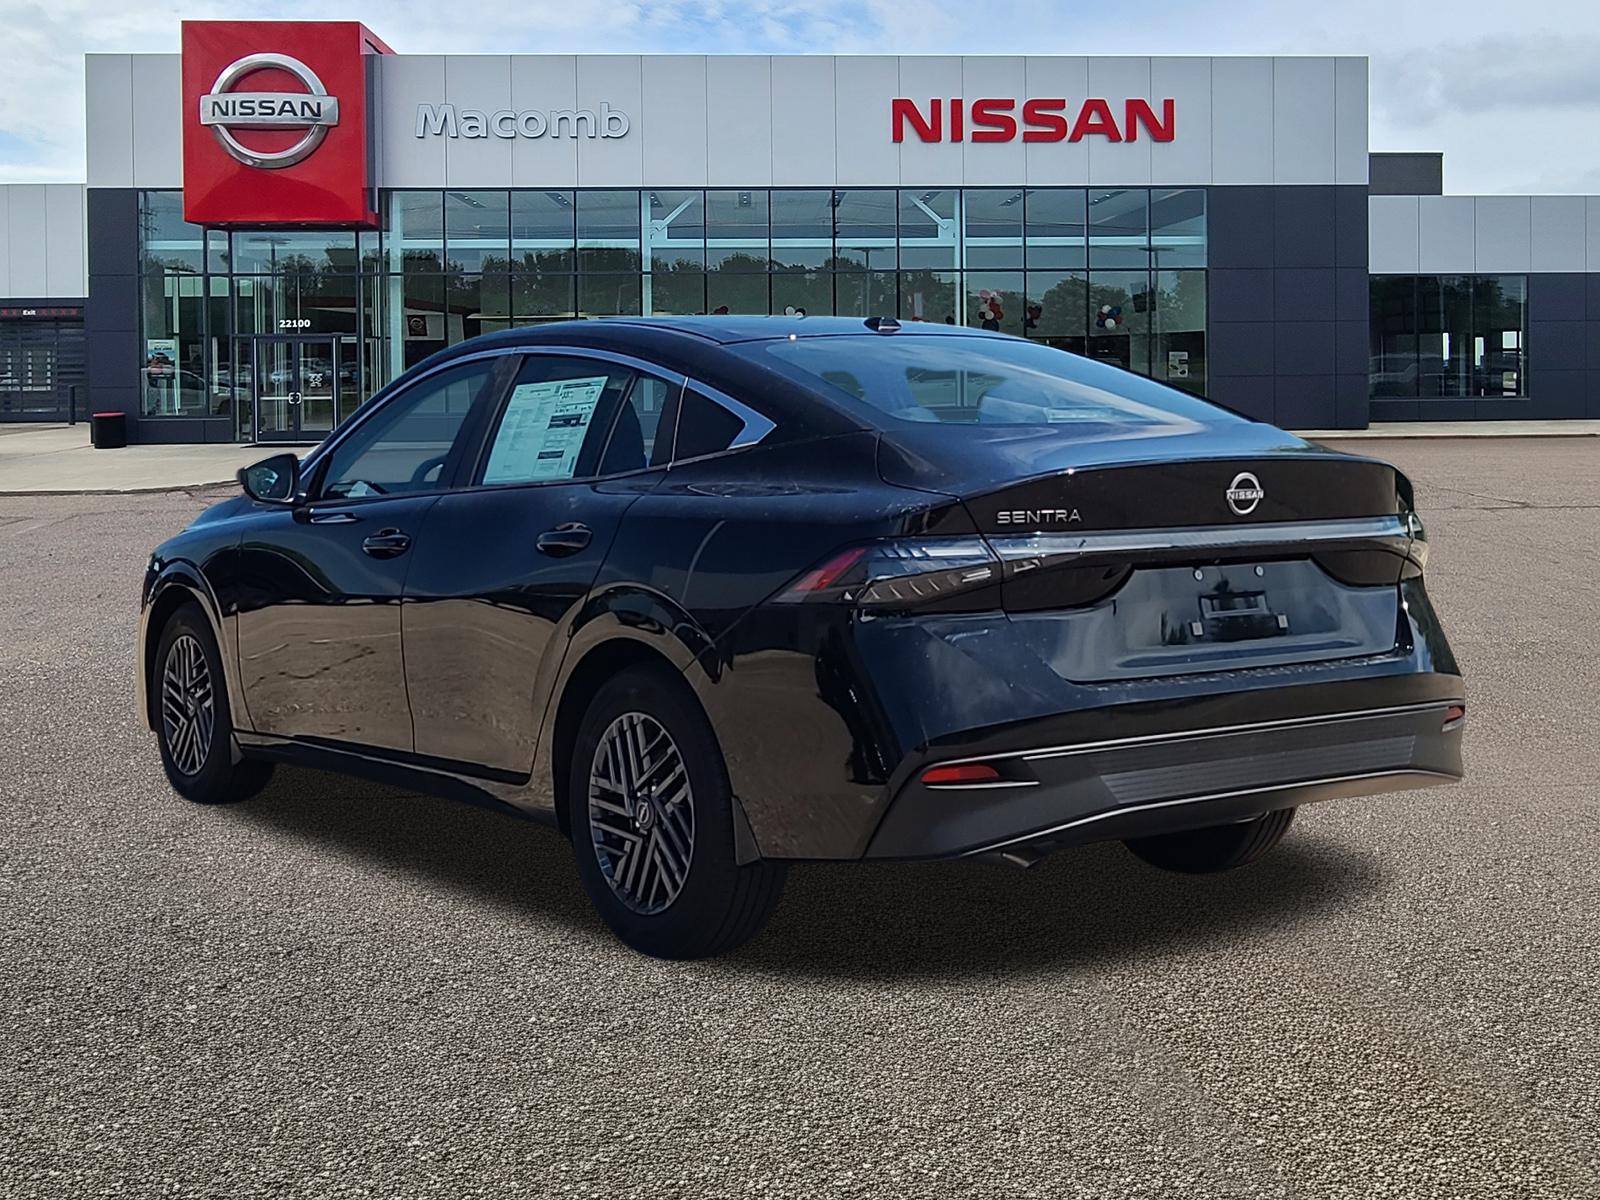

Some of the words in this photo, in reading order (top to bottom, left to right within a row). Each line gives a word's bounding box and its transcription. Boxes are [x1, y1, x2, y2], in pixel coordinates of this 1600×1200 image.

[212, 100, 322, 117] NISSAN
[415, 102, 630, 138] Macomb
[891, 98, 1175, 143] NISSAN
[279, 319, 311, 328] 22100
[1226, 489, 1264, 500] NISSAN
[997, 508, 1081, 524] SENTRA
